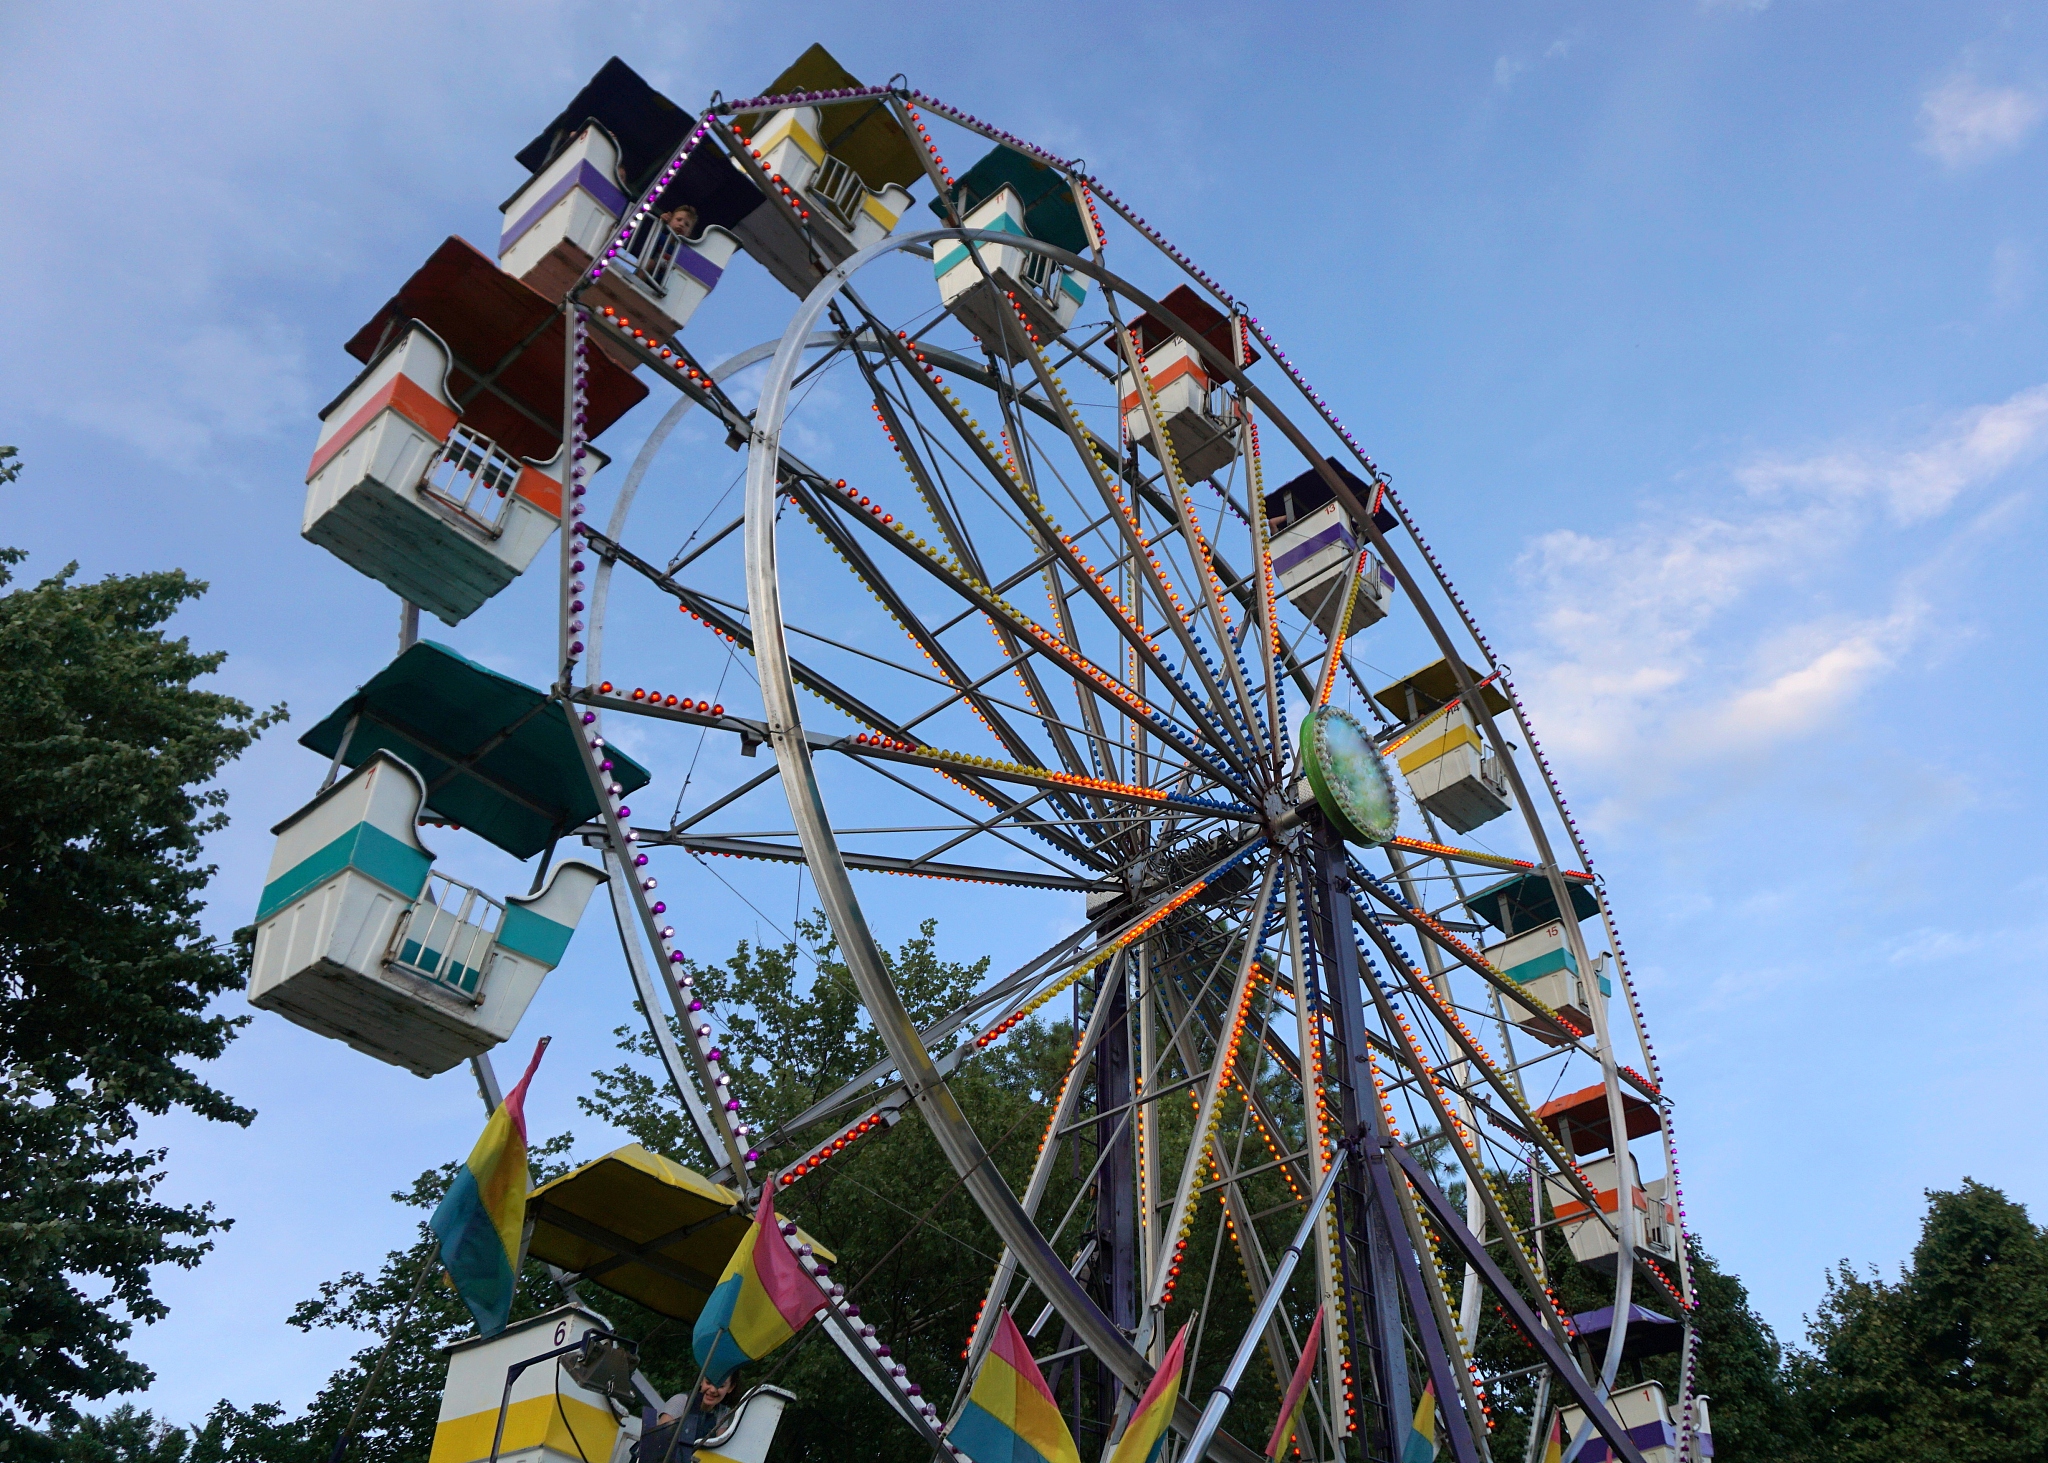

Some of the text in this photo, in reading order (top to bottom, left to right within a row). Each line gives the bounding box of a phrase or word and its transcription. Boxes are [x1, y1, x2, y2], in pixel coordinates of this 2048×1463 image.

[995, 193, 1005, 204] 11
[1172, 337, 1183, 347] 12
[1324, 503, 1336, 515] 13
[1545, 926, 1559, 938] 15
[553, 1321, 567, 1346] 6
[1642, 1390, 1650, 1402] 1
